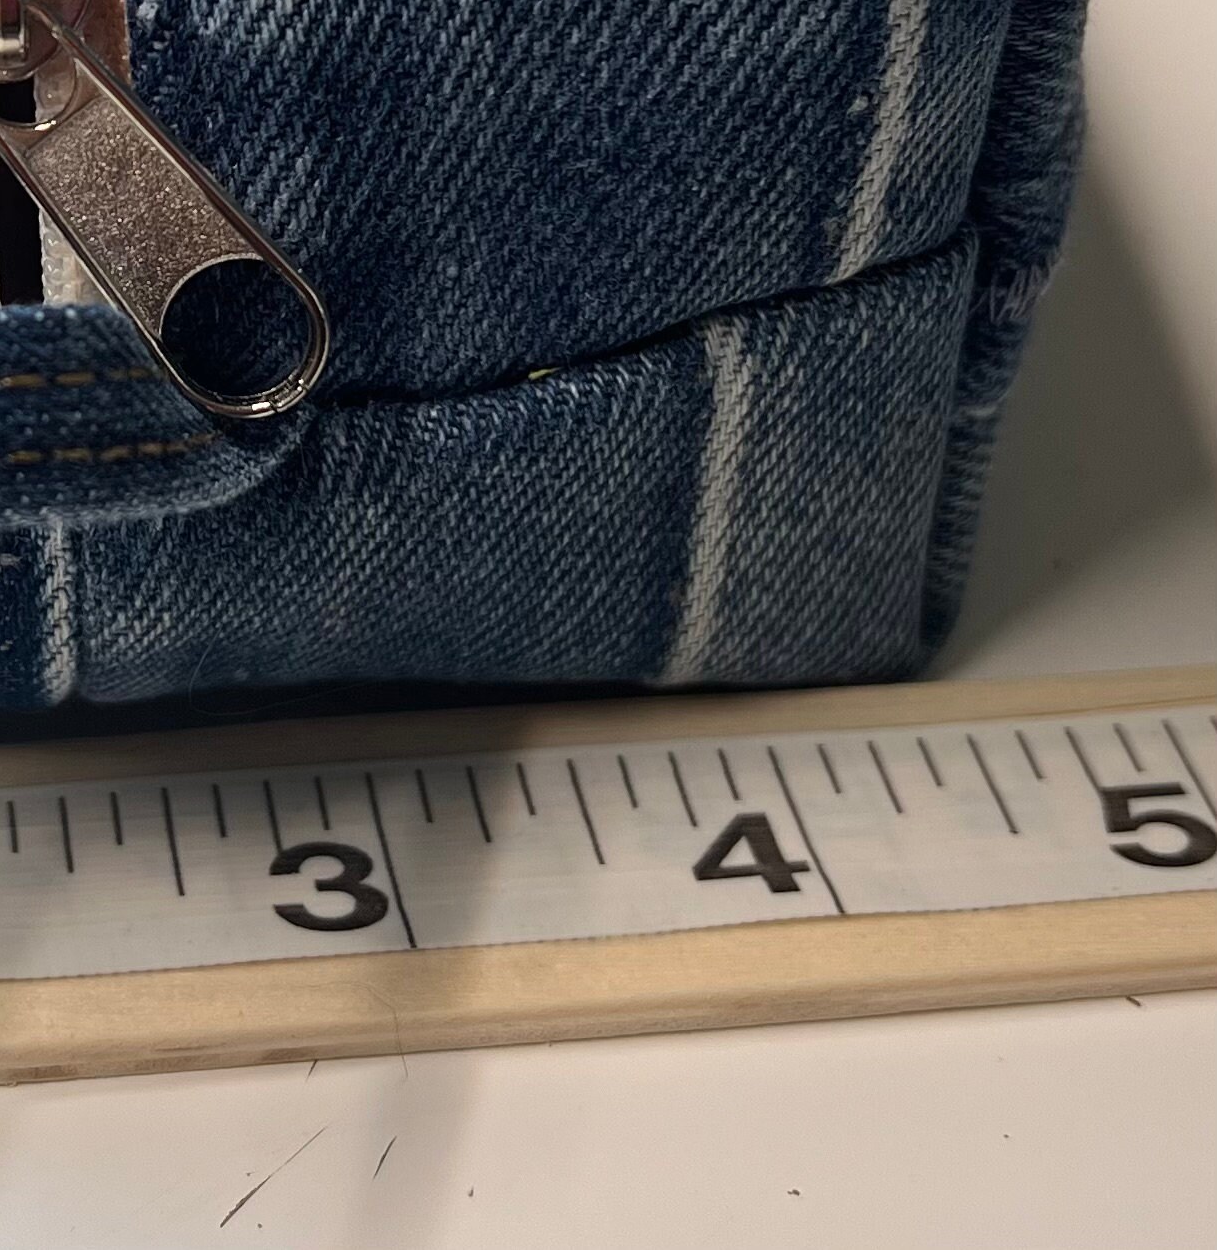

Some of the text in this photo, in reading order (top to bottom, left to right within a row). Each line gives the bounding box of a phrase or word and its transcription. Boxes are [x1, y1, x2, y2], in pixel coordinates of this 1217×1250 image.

[268, 841, 389, 931] 3
[692, 812, 811, 893] 4
[1099, 781, 1217, 868] 5
